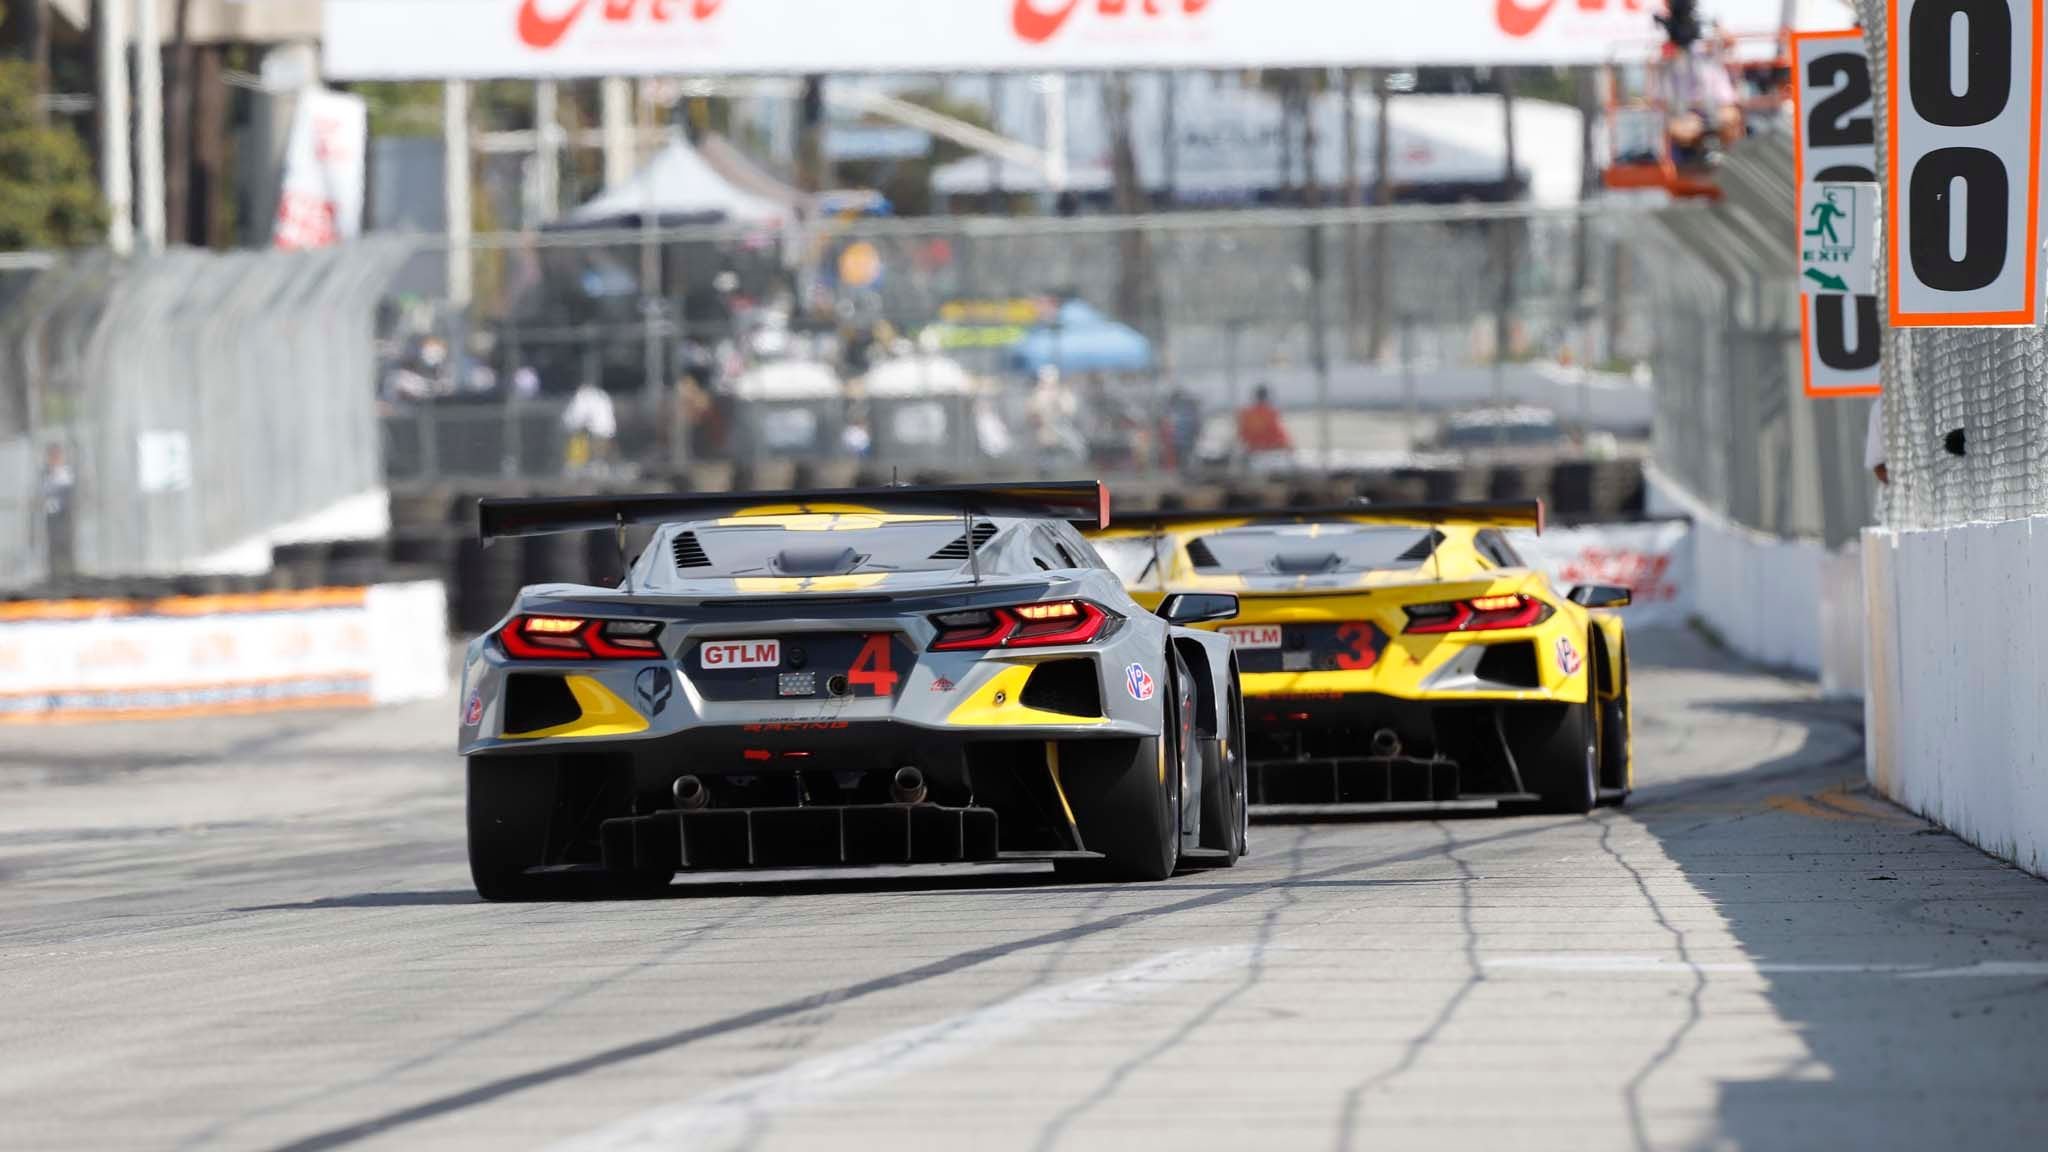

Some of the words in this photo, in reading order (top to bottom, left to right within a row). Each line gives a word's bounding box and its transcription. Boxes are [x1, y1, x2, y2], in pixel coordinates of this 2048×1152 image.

[1803, 251, 1850, 262] EXIT
[705, 644, 777, 664] GTLM
[1336, 621, 1377, 670] 3
[847, 632, 898, 696] 4
